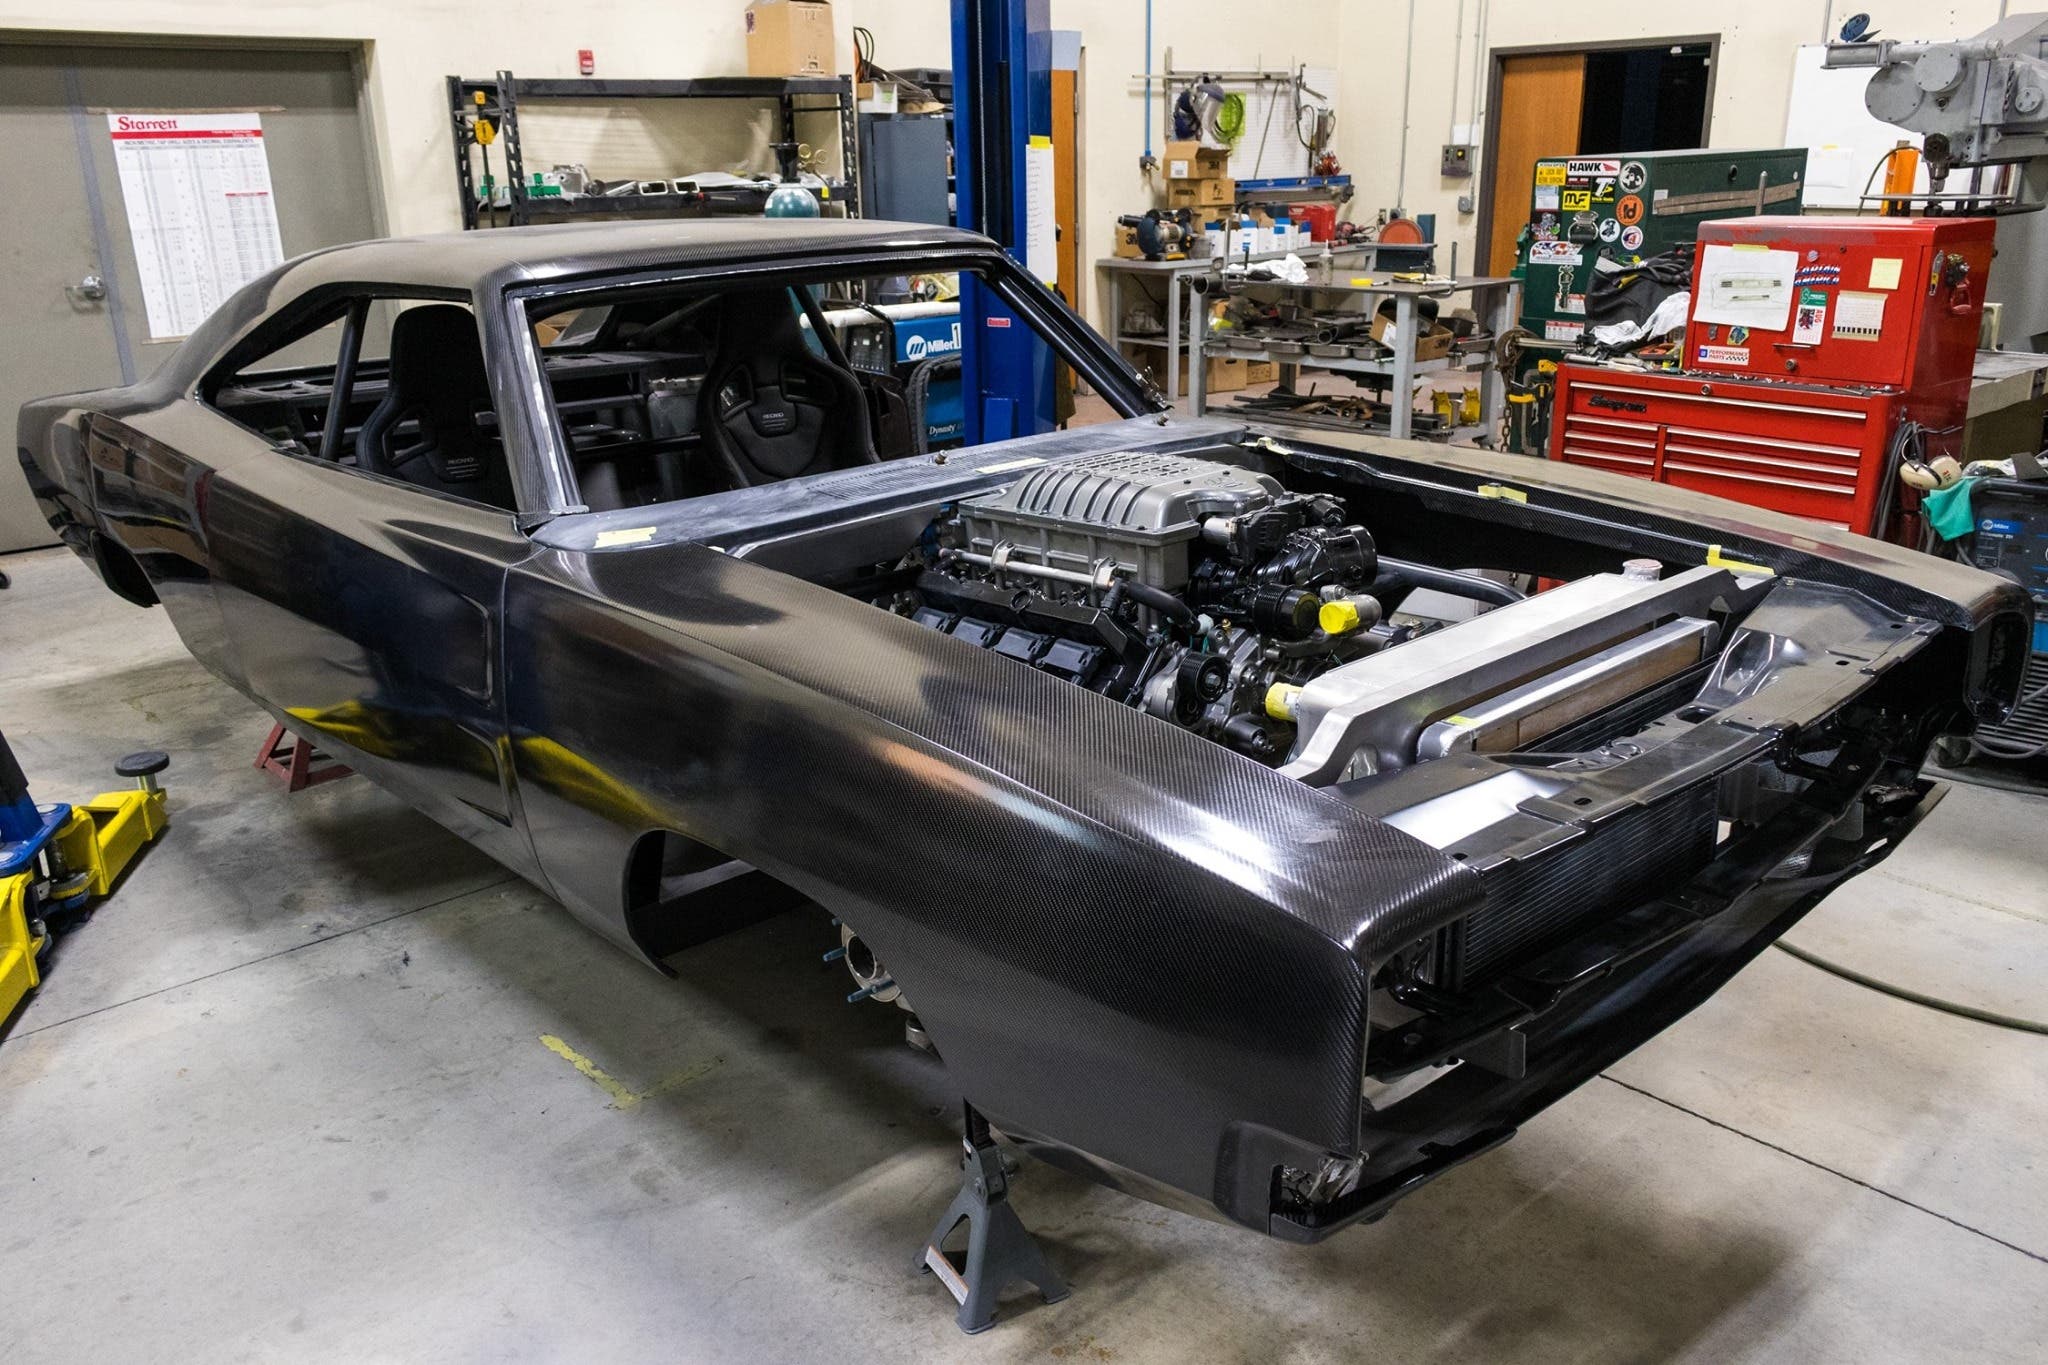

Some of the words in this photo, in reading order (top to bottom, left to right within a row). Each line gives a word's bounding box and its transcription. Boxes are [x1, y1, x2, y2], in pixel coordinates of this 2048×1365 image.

[118, 116, 178, 131] Starrett
[1569, 162, 1602, 172] HAWK
[927, 339, 954, 353] Miller
[929, 423, 957, 436] Dynasty
